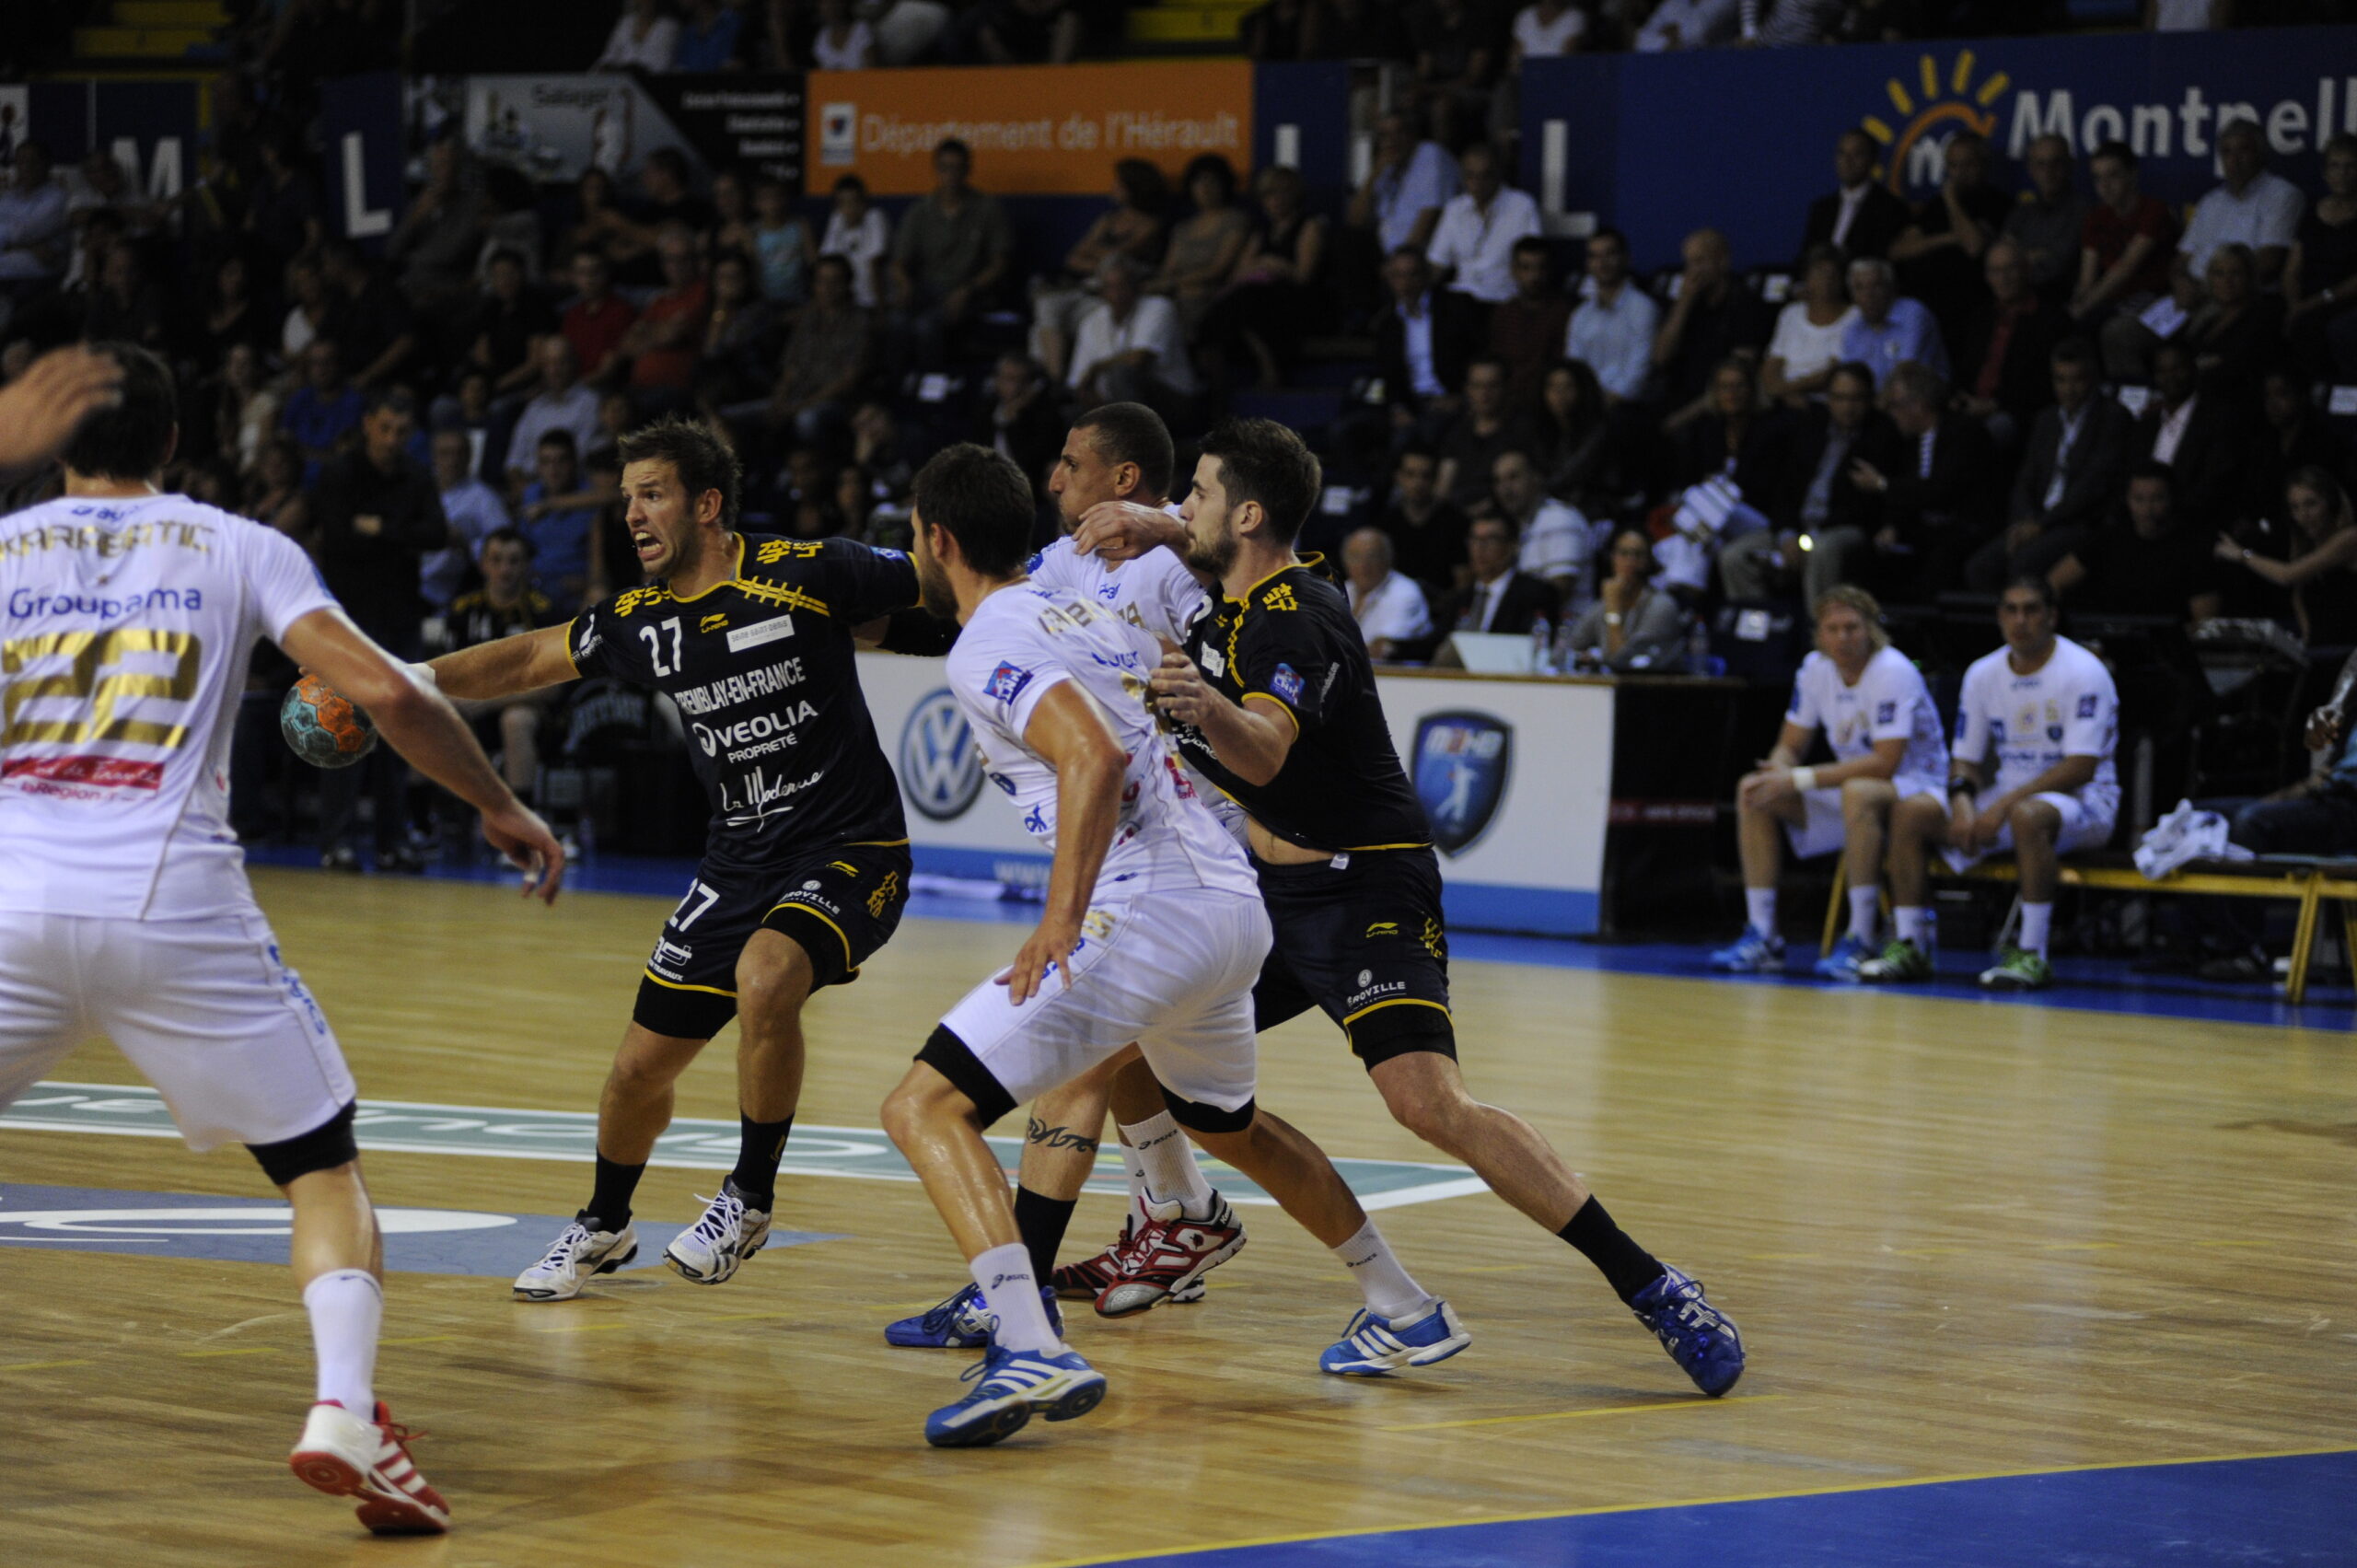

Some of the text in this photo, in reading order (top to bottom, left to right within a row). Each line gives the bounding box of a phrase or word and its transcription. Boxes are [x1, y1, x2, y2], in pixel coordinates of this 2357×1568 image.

[862, 111, 1053, 157] Département
[1057, 112, 1100, 149] de
[1105, 110, 1239, 149] l'Hérault
[9, 588, 203, 621] Groupama
[639, 616, 682, 678] 27
[1, 629, 202, 749] 22
[674, 656, 807, 715] TREMBLAY-EN-FRANCE
[714, 700, 819, 748] VEOLIA
[727, 731, 798, 764] PROPRETÉ
